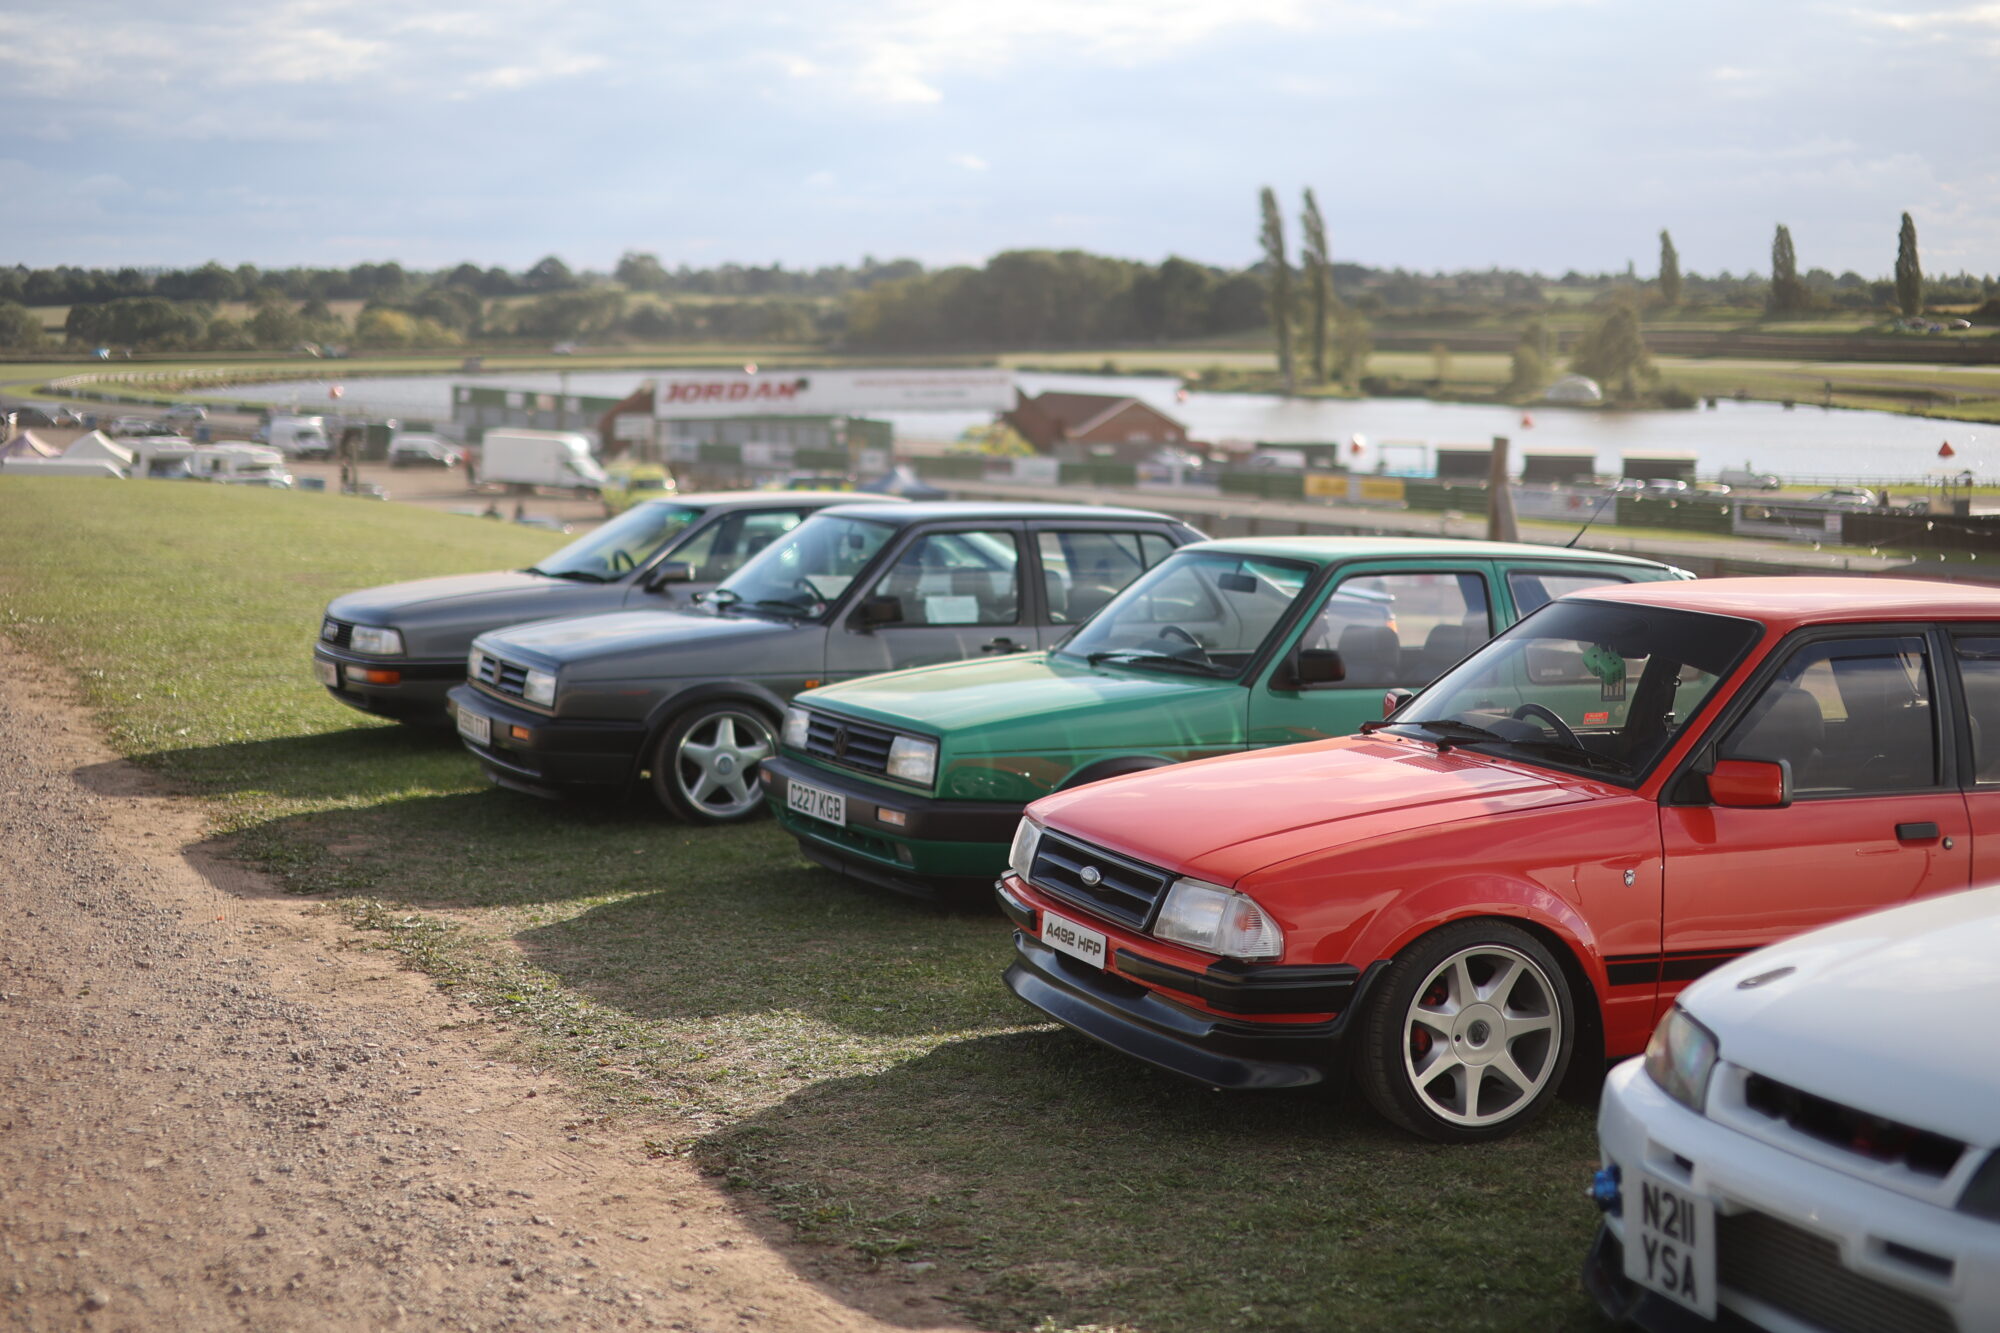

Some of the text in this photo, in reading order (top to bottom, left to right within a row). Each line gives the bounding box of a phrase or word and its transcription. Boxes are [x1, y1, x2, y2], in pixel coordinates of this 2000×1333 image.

[667, 382, 798, 402] JORDAN
[791, 784, 841, 821] C227 KGB
[1046, 922, 1101, 955] A492 HFP
[1642, 1181, 1695, 1249] N211
[1642, 1233, 1698, 1304] YSA
